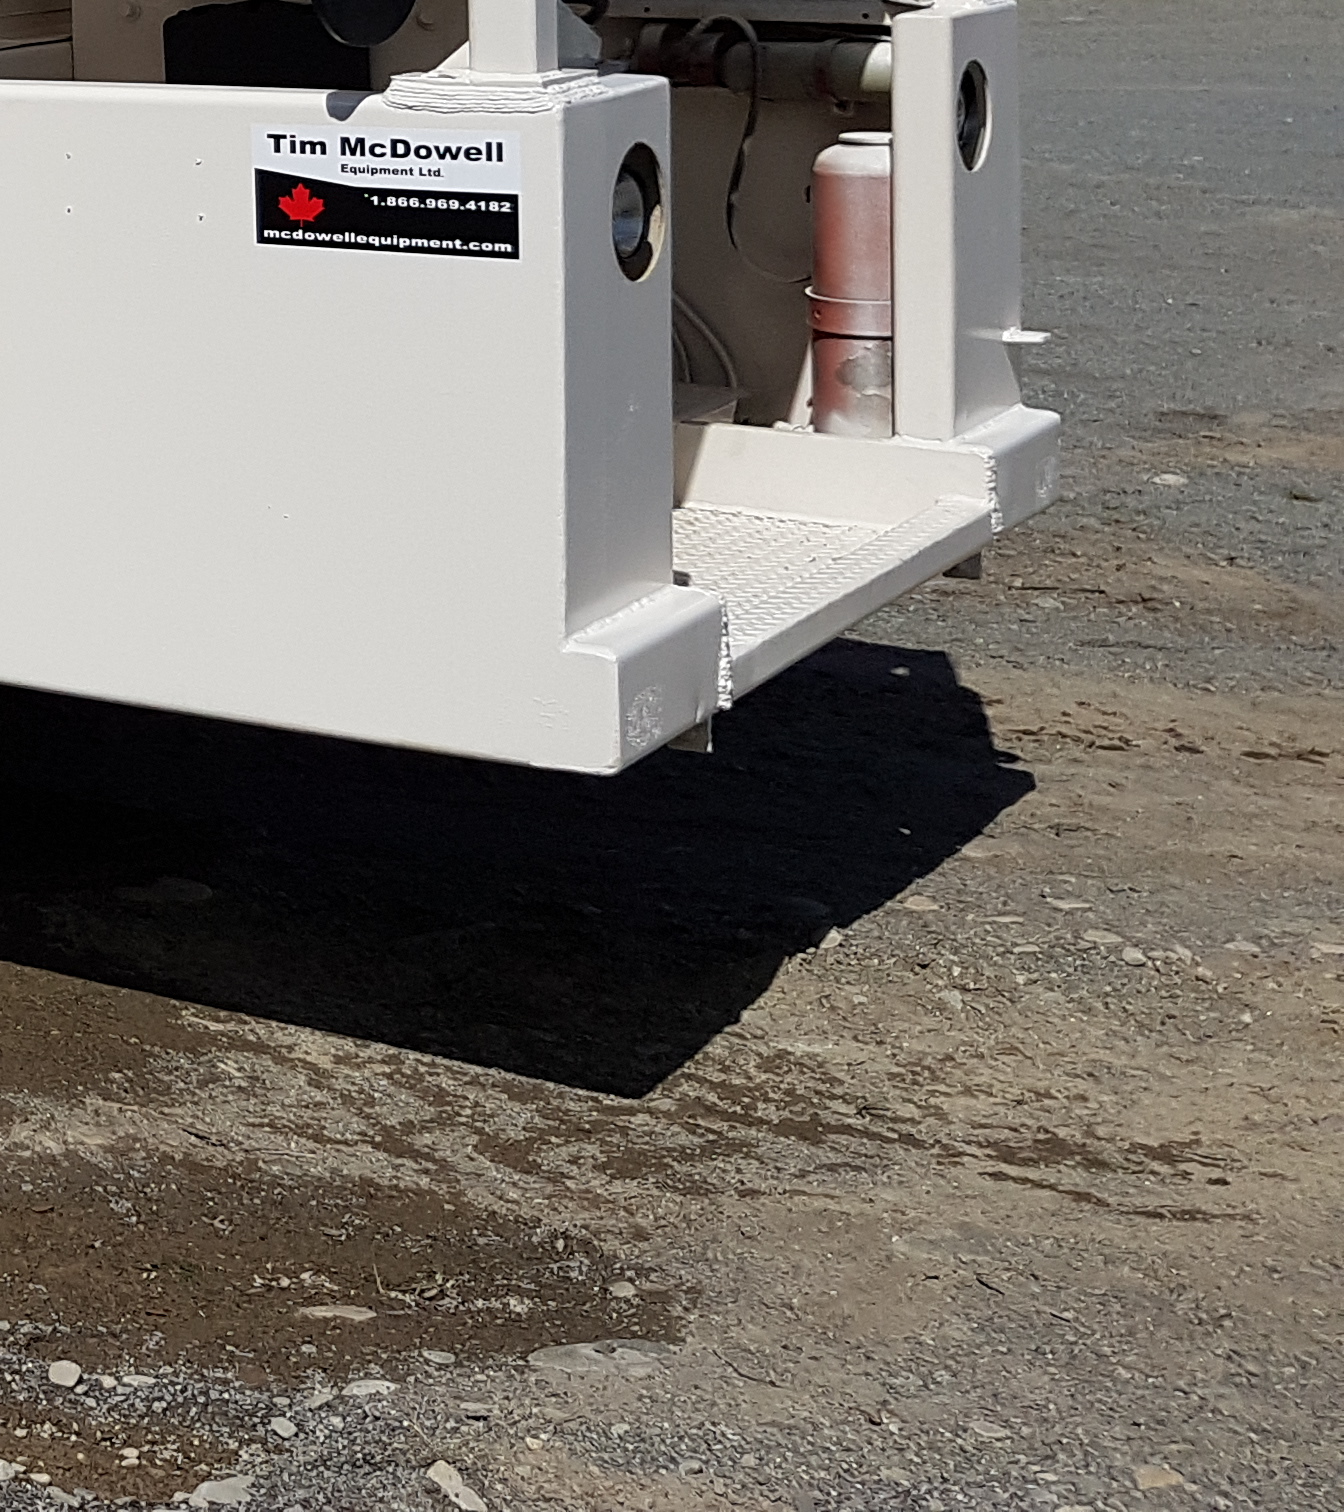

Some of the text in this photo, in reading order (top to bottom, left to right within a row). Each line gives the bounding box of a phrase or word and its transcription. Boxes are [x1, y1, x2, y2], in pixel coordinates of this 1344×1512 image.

[266, 133, 504, 163] Tim McDowell
[340, 163, 445, 178] Equipment Ltd.
[370, 195, 513, 213] 1.866.969.4182
[263, 228, 514, 253] mcdowellequipment.com
